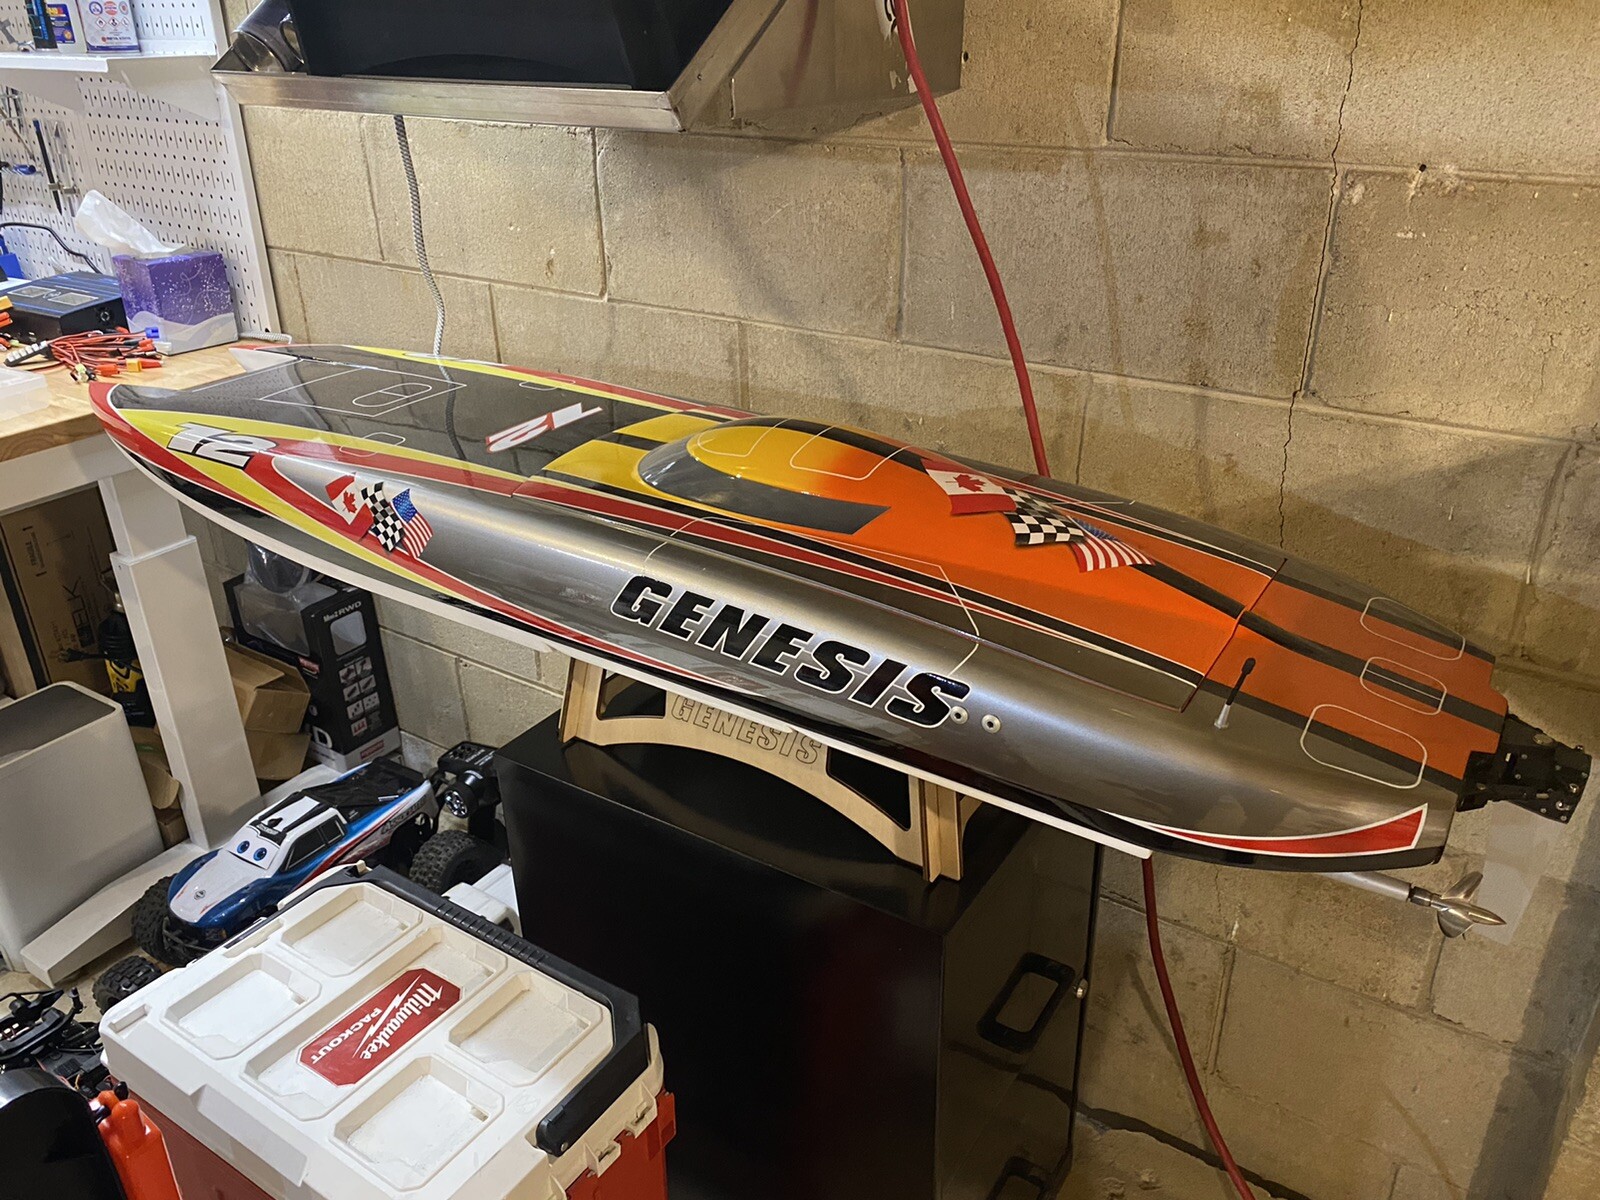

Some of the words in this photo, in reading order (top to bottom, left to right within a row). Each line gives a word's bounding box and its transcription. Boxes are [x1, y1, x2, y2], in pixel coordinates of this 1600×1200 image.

[167, 421, 277, 470] 12
[610, 574, 971, 728] GENESIS
[671, 694, 824, 764] GENESIS
[310, 1007, 383, 1064] PACKOUT
[360, 982, 443, 1060] Milwaukee
